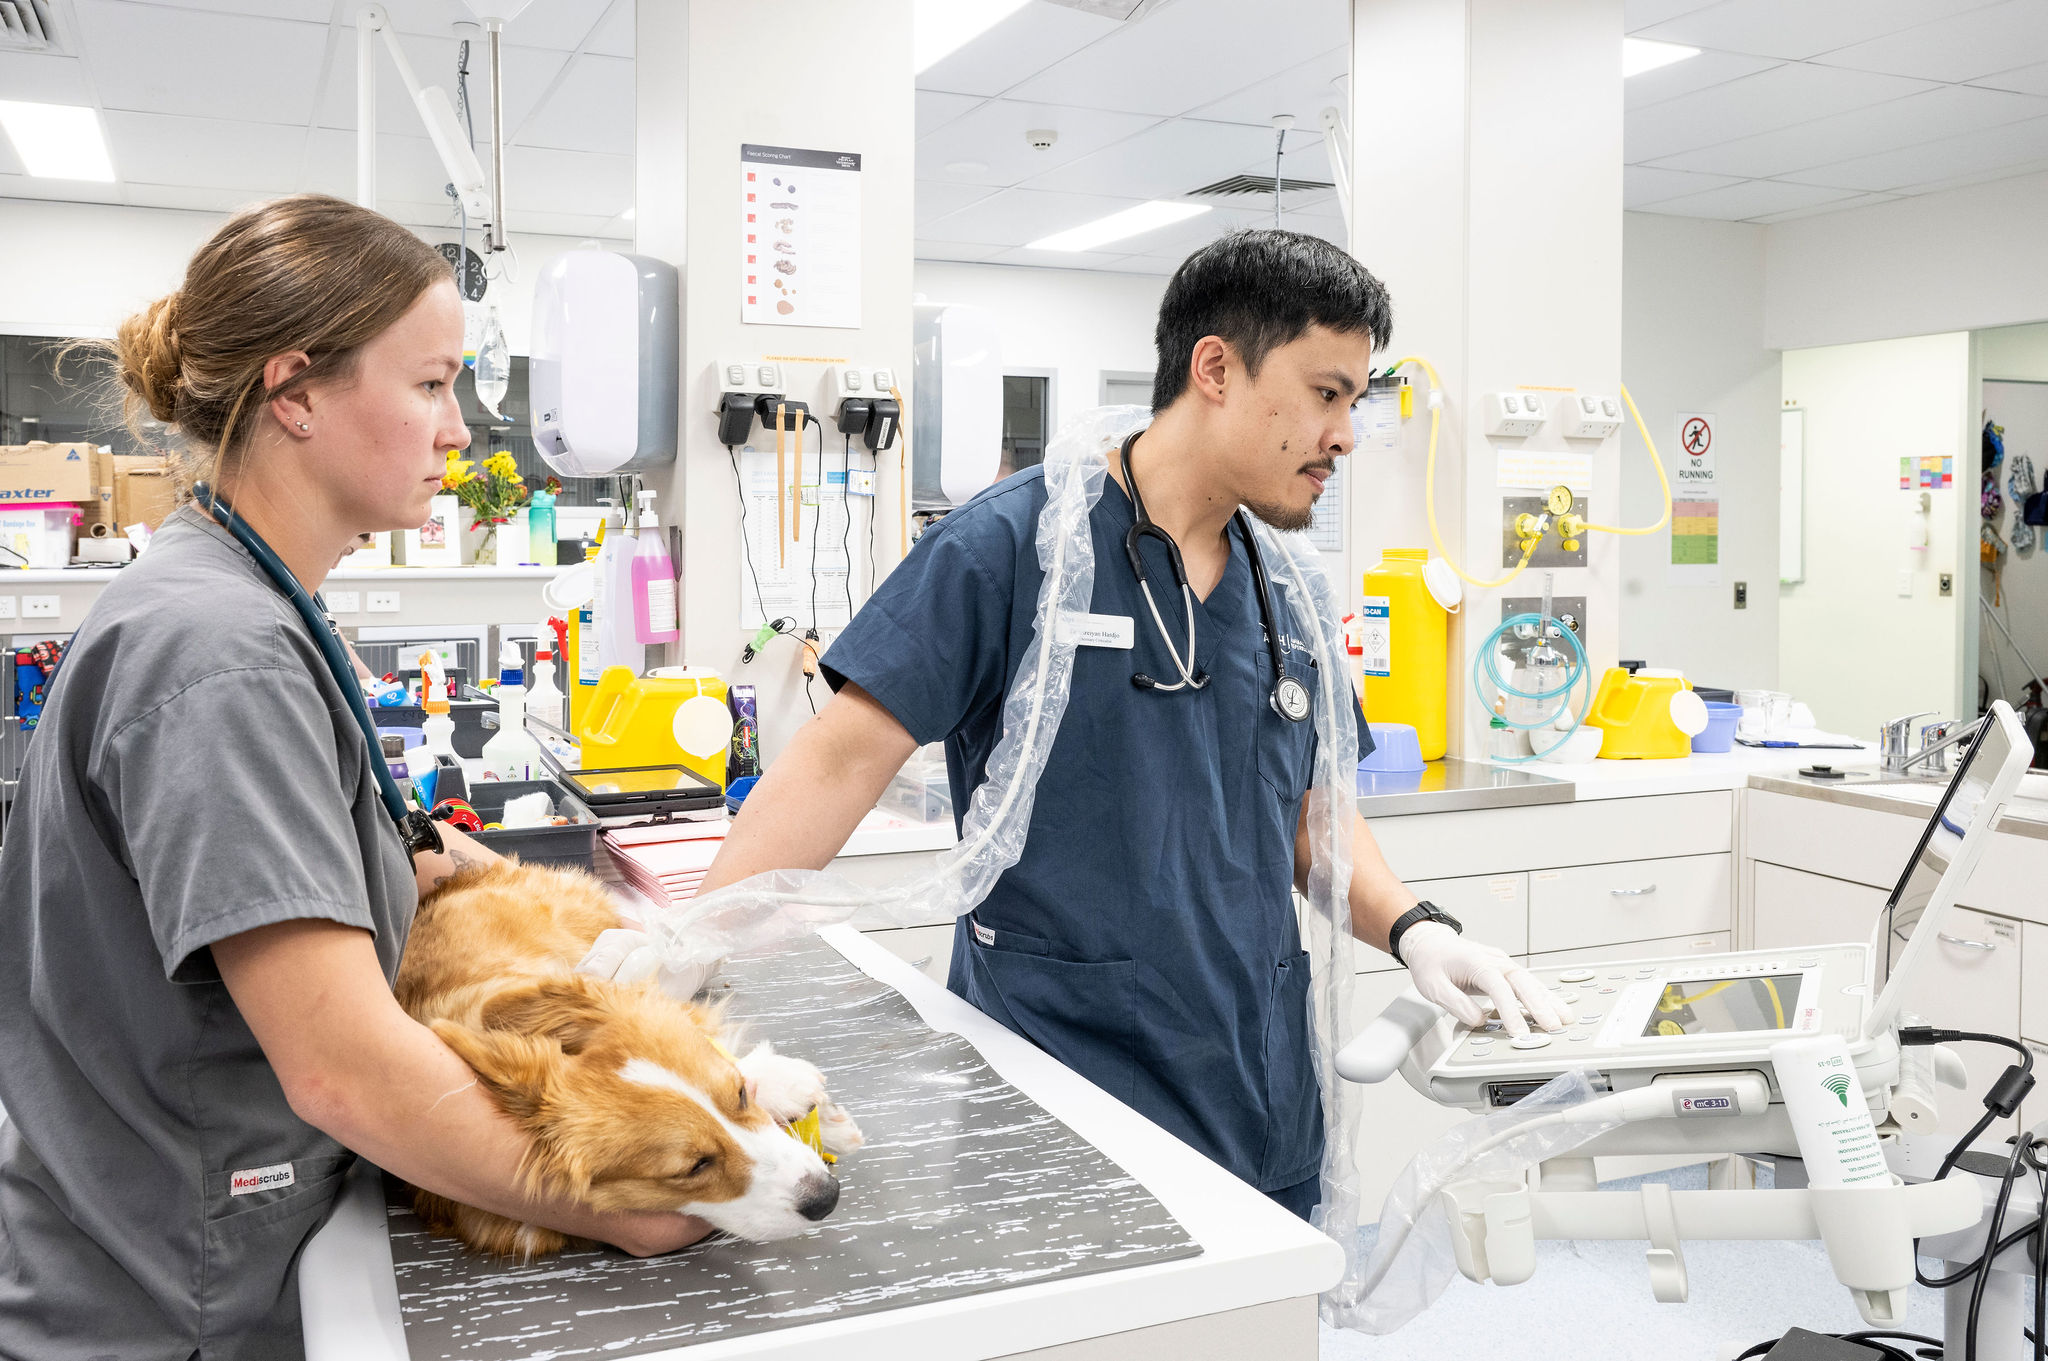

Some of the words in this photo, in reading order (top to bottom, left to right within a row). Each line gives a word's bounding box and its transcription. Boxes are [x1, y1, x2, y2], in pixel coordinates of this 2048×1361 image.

[762, 152, 778, 160] Scoring
[470, 262, 478, 272] 2
[475, 275, 482, 285] 3
[471, 288, 478, 297] 4
[1690, 459, 1702, 468] NO
[1679, 470, 1714, 480] RUNNING
[1263, 632, 1286, 646] AH
[1696, 1099, 1709, 1108] mC
[1710, 1098, 1728, 1108] 3-11
[1840, 1156, 1865, 1164] ULTRASONS
[234, 1171, 291, 1189] Mediscrubs
[1842, 1173, 1875, 1184] ULTRASONIDOS
